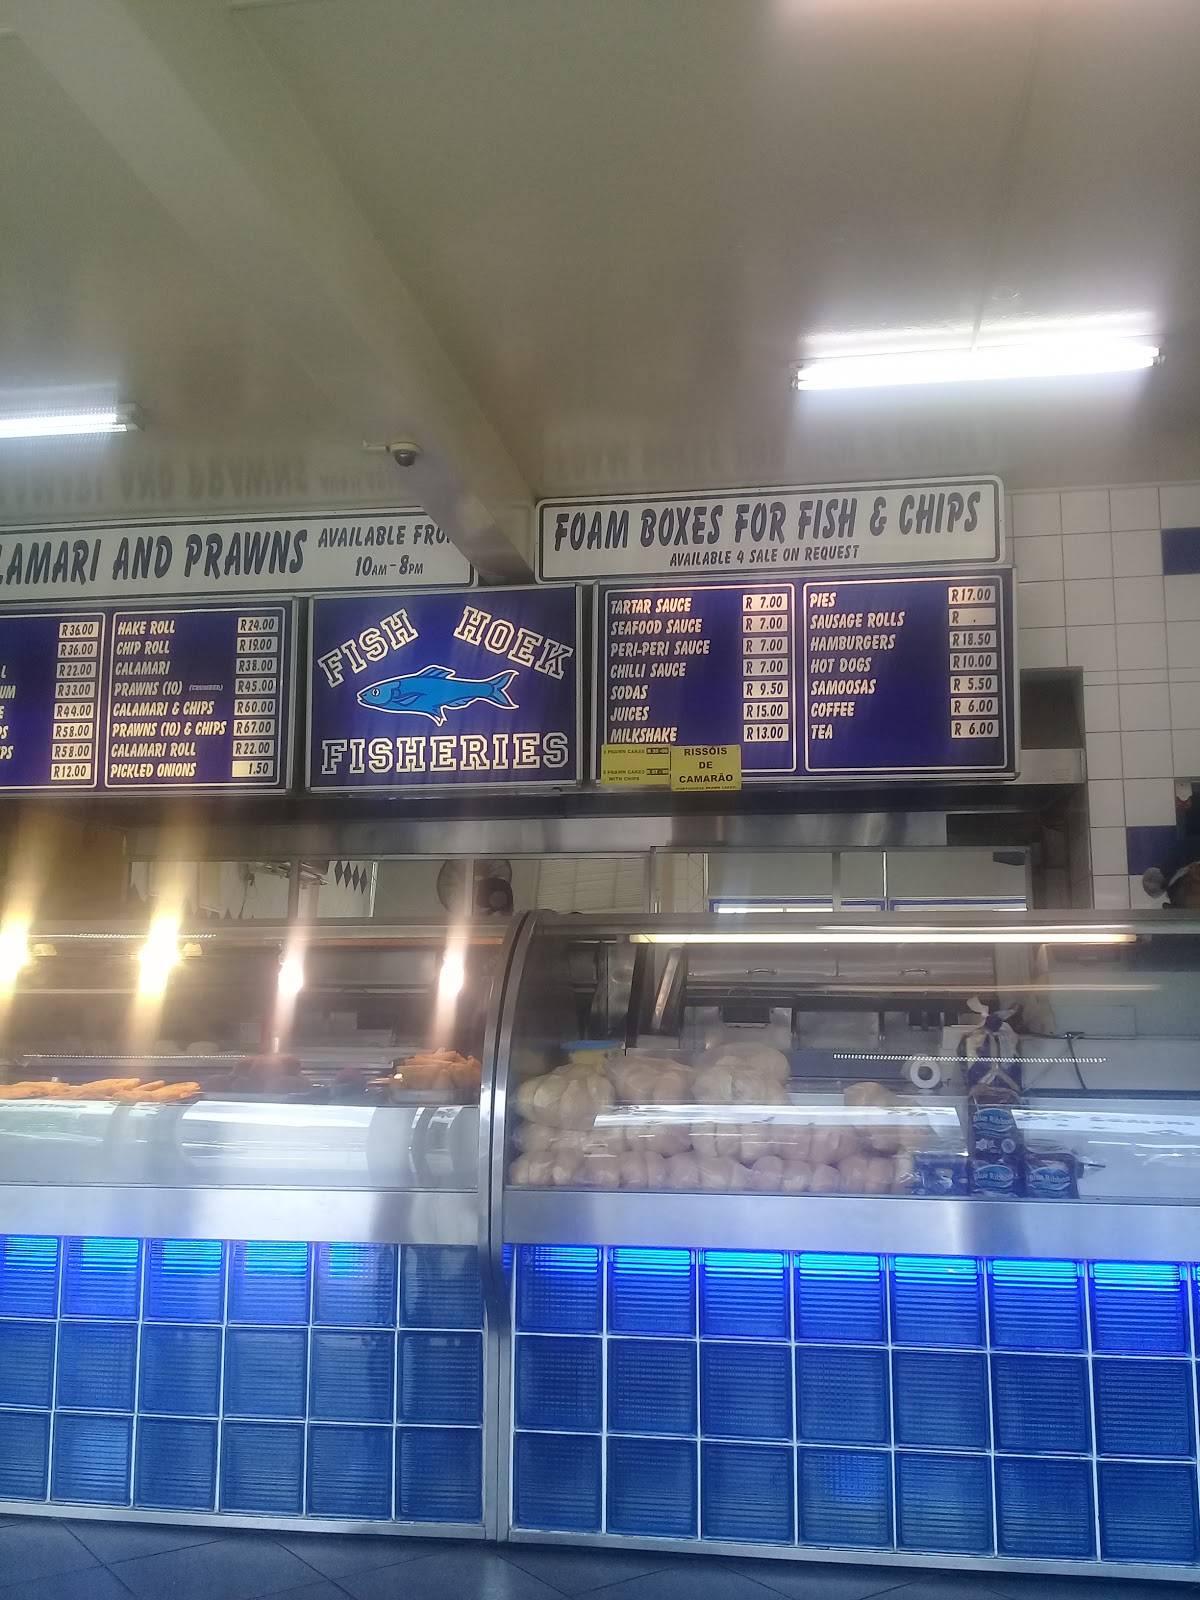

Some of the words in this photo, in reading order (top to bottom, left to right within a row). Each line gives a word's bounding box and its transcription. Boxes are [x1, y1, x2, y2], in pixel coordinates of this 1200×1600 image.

[554, 510, 629, 551] FOAM
[640, 504, 724, 547] BOXES
[735, 501, 786, 545] FOR
[798, 498, 858, 540] FISH
[870, 497, 887, 536] &
[899, 491, 982, 536] CHIPS
[318, 526, 406, 548] AVAILABLE
[414, 524, 450, 545] FRO
[0, 538, 102, 585] AMARI
[112, 535, 174, 580] AND
[184, 529, 308, 580] PRAWNS
[670, 550, 731, 567] AVAILABLE
[736, 549, 745, 564] 4
[749, 548, 778, 563] SALE
[782, 547, 800, 561] ON
[804, 545, 860, 561] REQUEST
[611, 600, 651, 614] TARTAR
[656, 597, 691, 612] SAUCE
[810, 593, 836, 607] PIES
[117, 621, 147, 635] HAKE
[150, 620, 175, 635] ROLL
[611, 621, 662, 635] SEAFOOD
[666, 619, 702, 634] SAUCE
[810, 613, 863, 629] SAUSAGE
[867, 612, 905, 627] ROLLS
[116, 641, 141, 655] CHIP
[144, 641, 170, 655] ROLL
[317, 608, 420, 688] FISH
[453, 605, 574, 680] HOEK
[610, 642, 669, 657] PERI-PERI
[674, 640, 710, 655] SAUCE
[811, 634, 896, 651] HAMBURGERS
[116, 661, 170, 676] CALAMARI
[610, 664, 645, 678] CHILLI
[650, 662, 686, 677] SAUCE
[811, 659, 835, 673] HOT
[840, 658, 871, 672] DOGS
[114, 682, 159, 696] PRAWNS
[162, 681, 182, 695] (10)
[610, 685, 648, 700] SODAS
[811, 680, 876, 695] SAMOOSAS
[113, 702, 168, 717] CALAMARI
[172, 702, 180, 715] &
[183, 701, 214, 715] CHIPS
[610, 706, 649, 721] JUICES
[811, 702, 855, 717] COFFEE
[112, 723, 157, 737] PRAWNS
[161, 722, 180, 736] (10)
[184, 722, 191, 735] &
[195, 721, 227, 735] CHIPS
[610, 727, 678, 744] MILKSHAKE
[811, 725, 833, 740] TEA
[111, 743, 166, 758] CALAMARI
[171, 742, 196, 756] ROLL
[321, 732, 569, 775] FISHERIES
[684, 747, 727, 756] RISSÓIS
[110, 763, 153, 778] PICKLED
[157, 763, 196, 777] ONIONS
[679, 773, 733, 783] CAMARÃO
